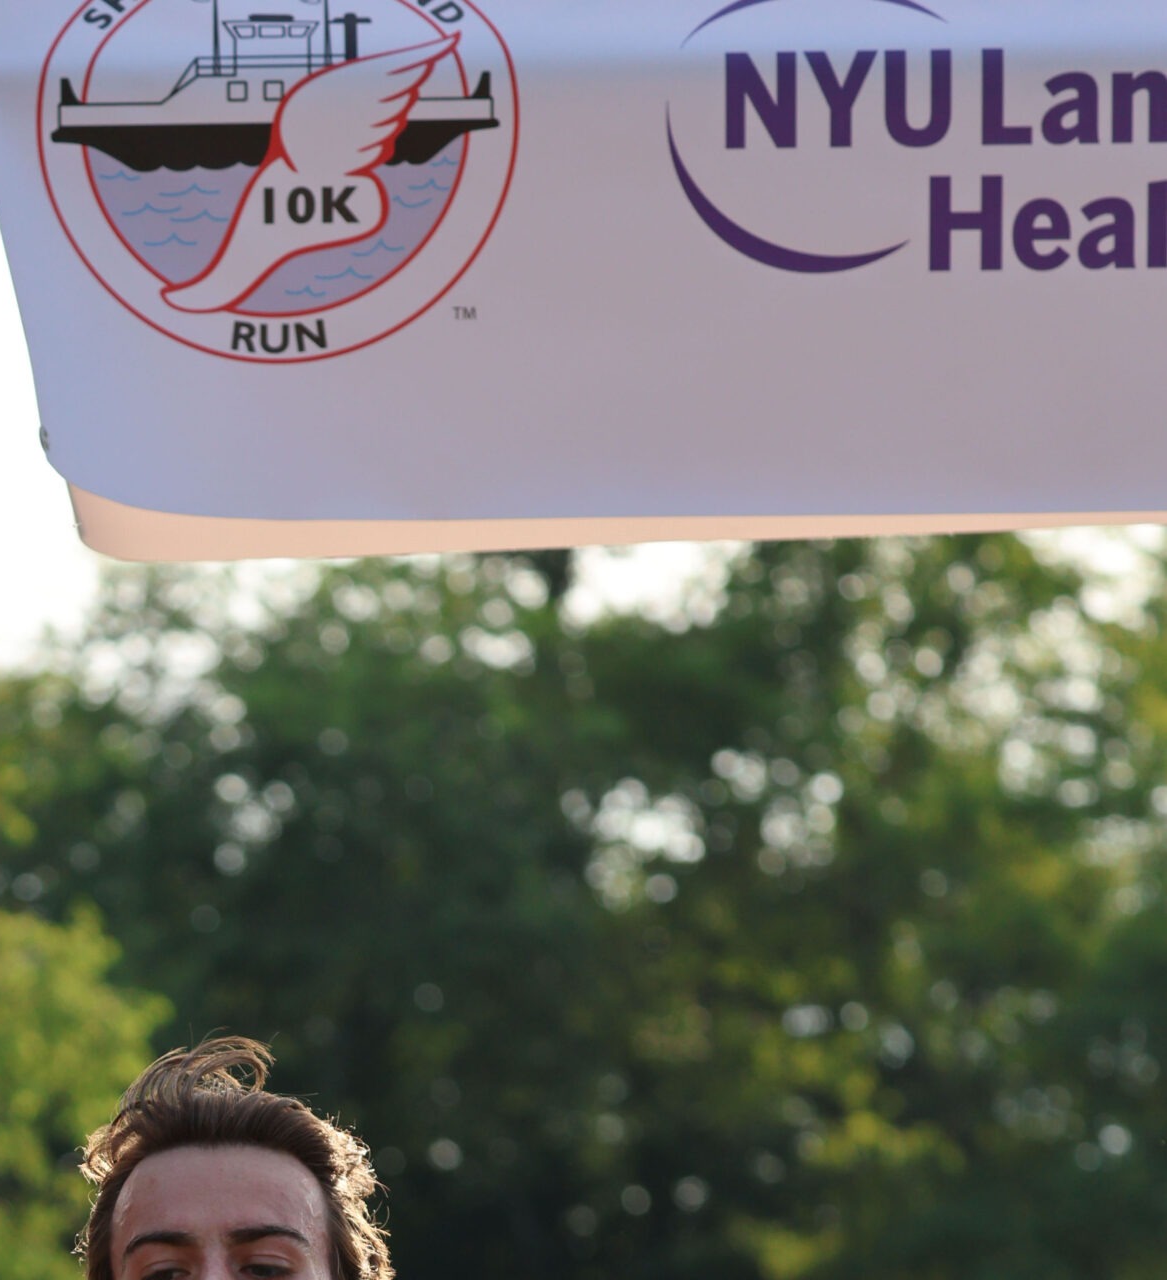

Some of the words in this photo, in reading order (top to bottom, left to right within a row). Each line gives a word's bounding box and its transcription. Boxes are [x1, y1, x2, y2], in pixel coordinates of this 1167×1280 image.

[724, 48, 952, 149] NYU
[980, 48, 1167, 146] Lan
[262, 185, 360, 225] 10K
[928, 174, 1167, 272] Heal
[452, 305, 478, 321] TM
[230, 318, 328, 355] RUN
